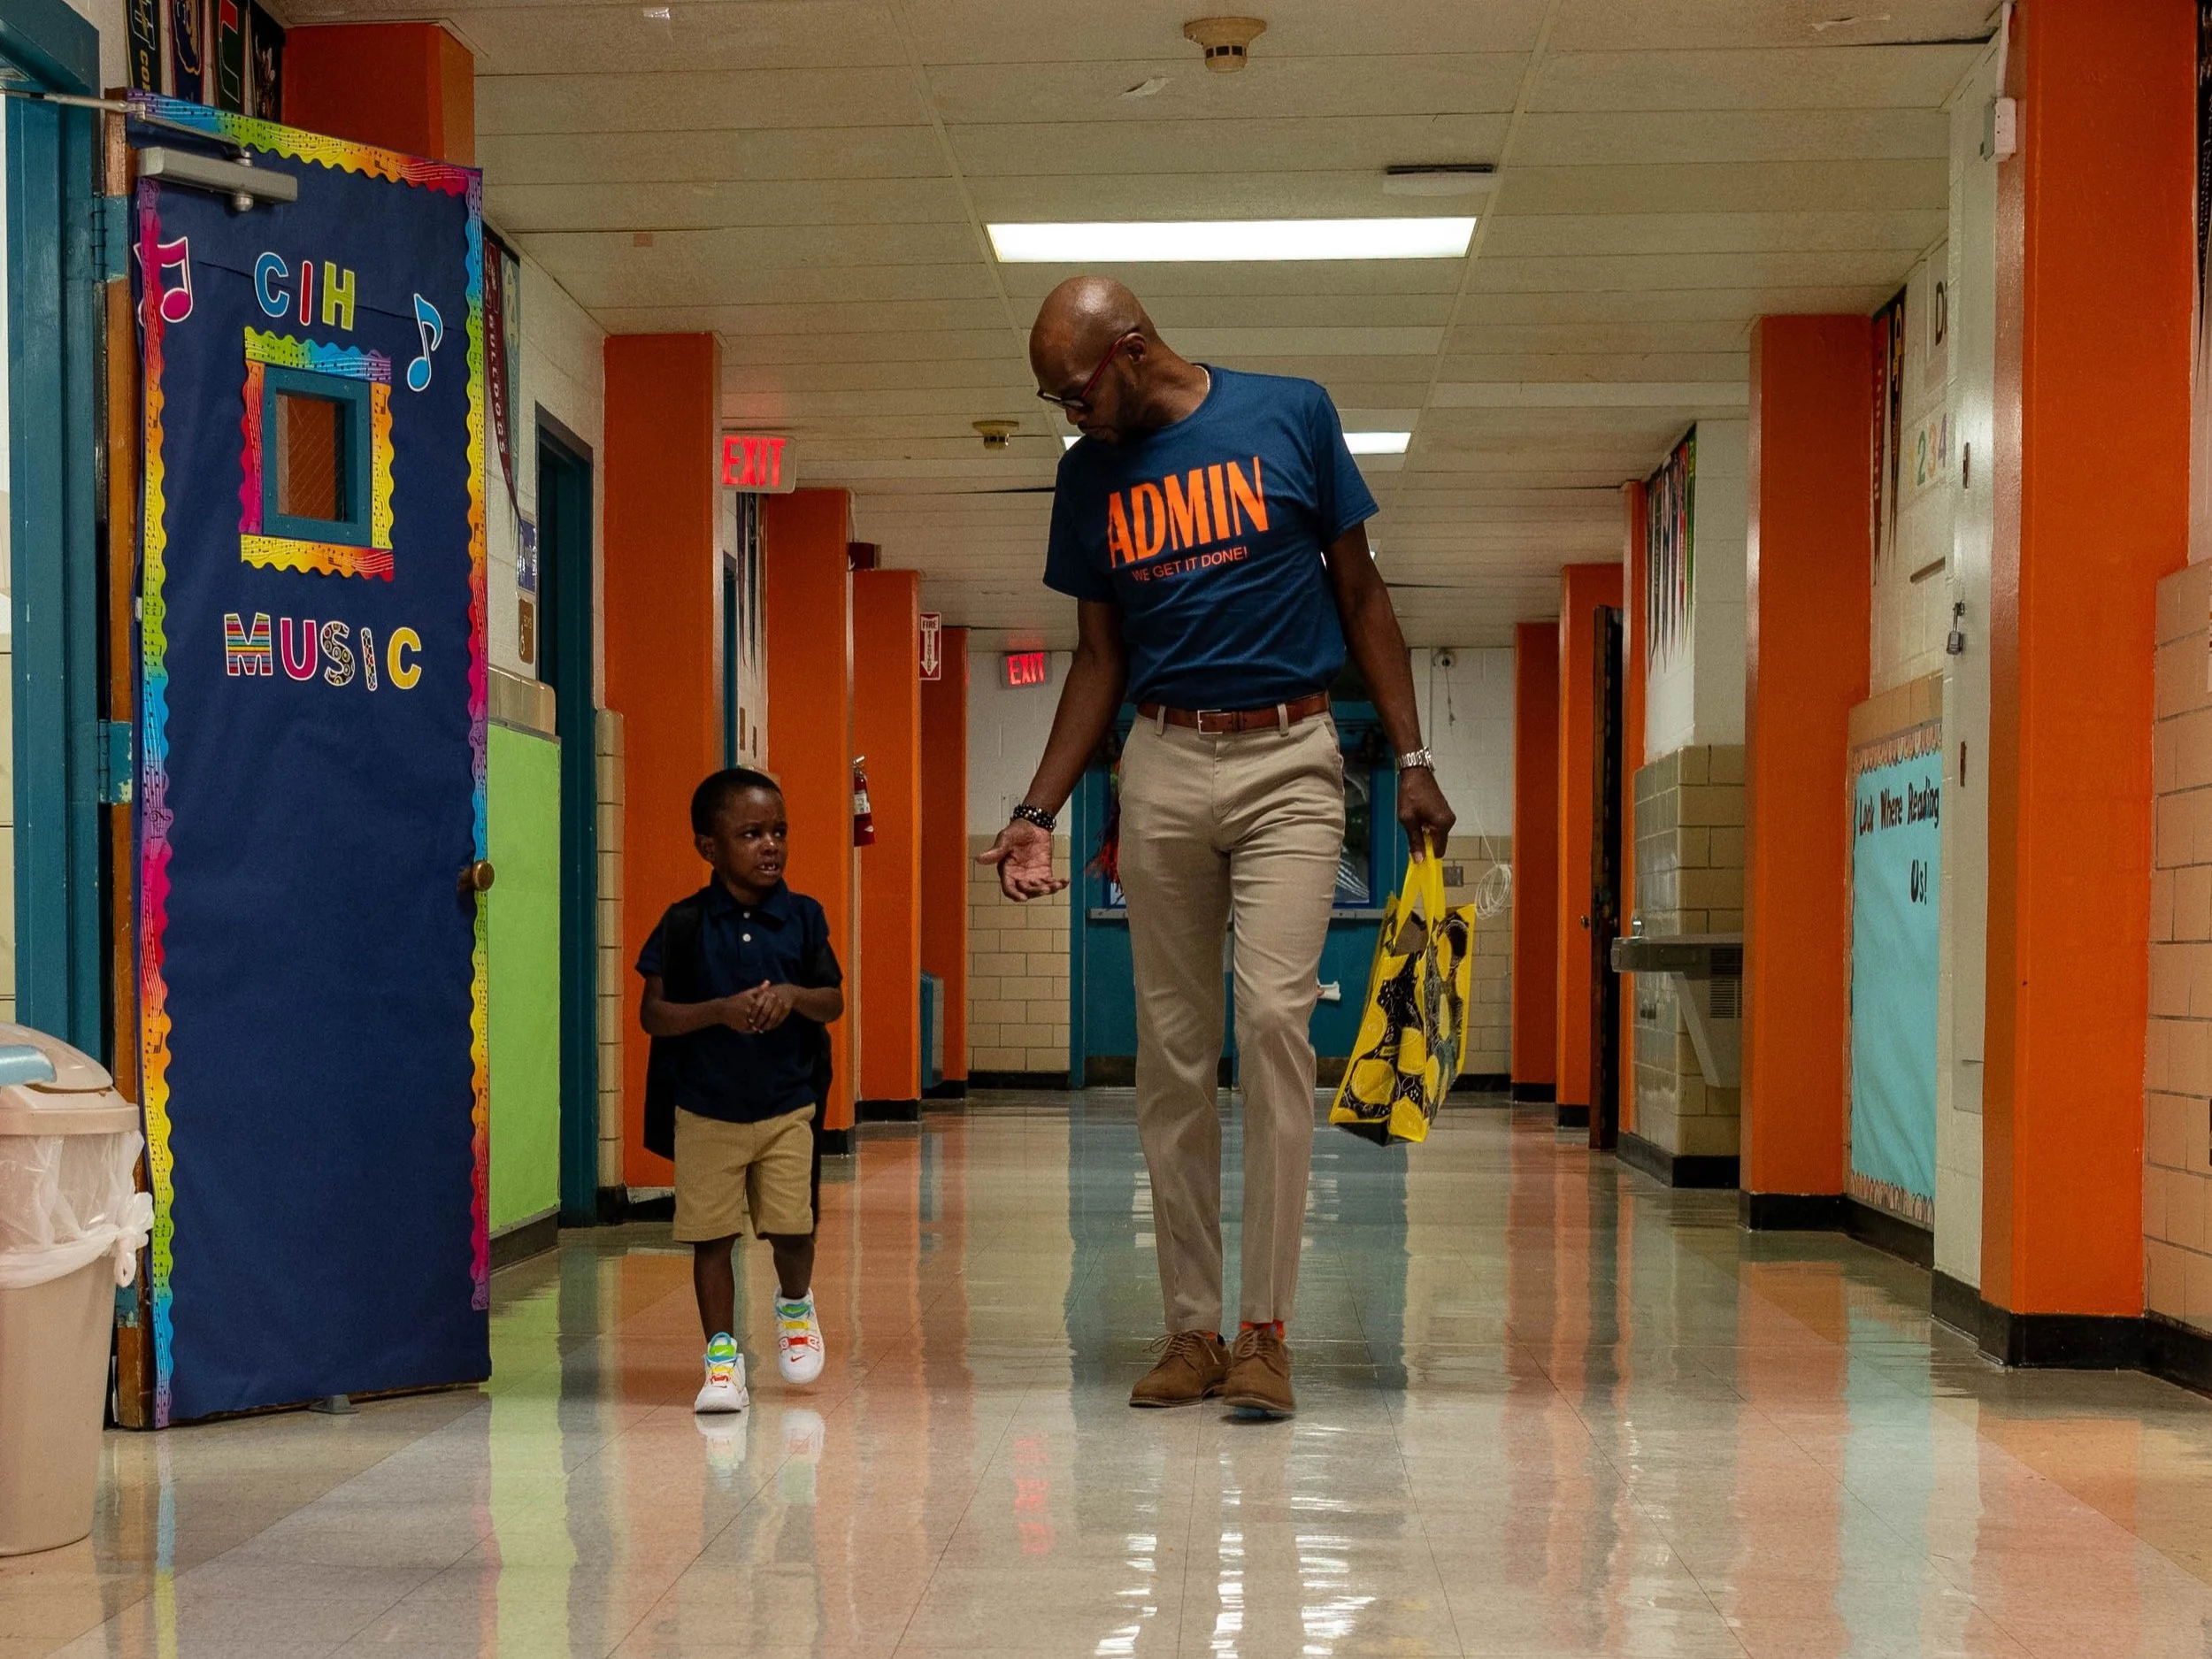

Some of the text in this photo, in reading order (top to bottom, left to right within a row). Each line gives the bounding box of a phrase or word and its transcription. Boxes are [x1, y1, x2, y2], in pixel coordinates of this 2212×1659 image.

[255, 251, 355, 331] CIH
[488, 314, 507, 453] BULLDOGS
[721, 435, 786, 488] EXIT
[1108, 457, 1269, 569] ADMIN
[1132, 546, 1248, 581] WE GET IT DONE!
[224, 612, 422, 691] MUSIC
[923, 620, 937, 629] FIRE
[1008, 652, 1045, 685] EXIT
[1860, 775, 1939, 836] Look Where Reading
[1911, 859, 1927, 905] Us!
